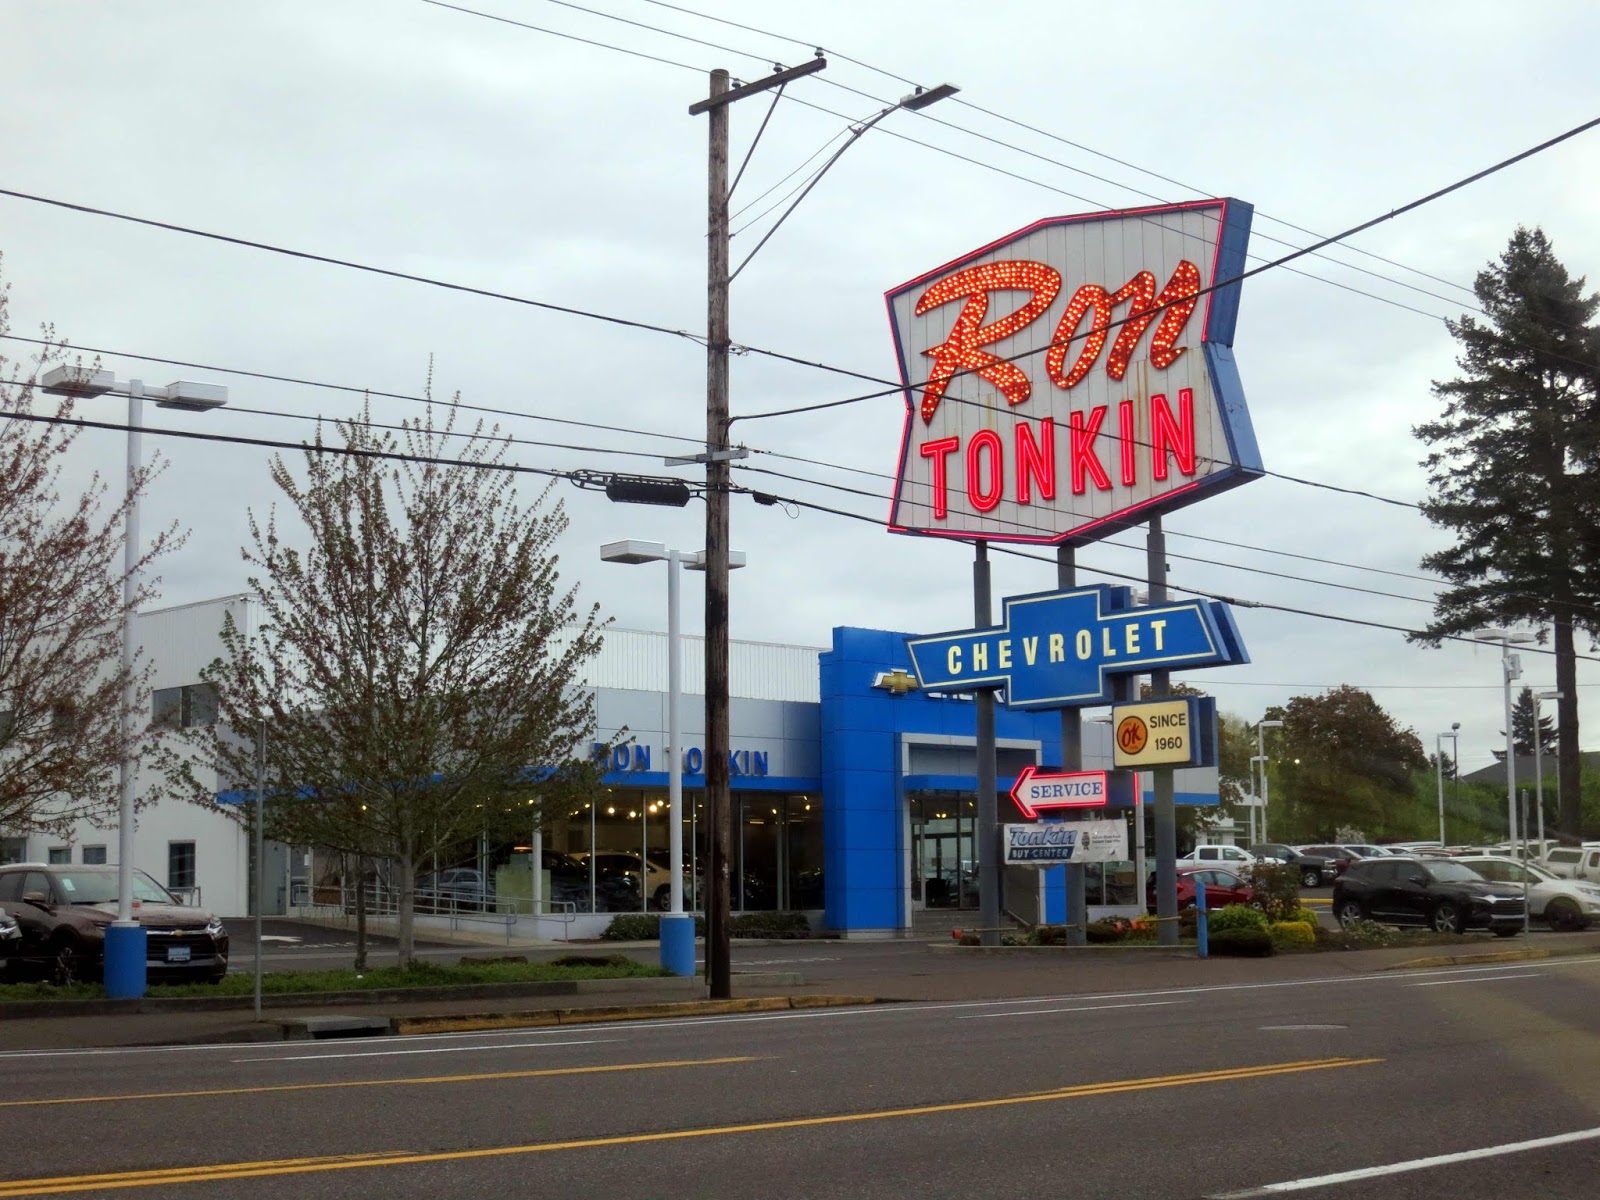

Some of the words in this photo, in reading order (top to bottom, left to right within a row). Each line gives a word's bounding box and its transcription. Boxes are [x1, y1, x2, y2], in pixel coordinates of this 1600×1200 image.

[915, 259, 1200, 426] Ron
[920, 387, 1196, 520] TONKIN
[947, 619, 1167, 675] CHEVROLET
[1149, 713, 1187, 729] SINCE
[1122, 723, 1142, 748] OK
[1155, 736, 1183, 751] 1960
[664, 747, 768, 776] OKIN
[1031, 782, 1103, 799] SERVICE
[1009, 826, 1078, 847] Tonkin
[1012, 849, 1028, 858] BUY
[1031, 849, 1068, 858] CENTER
